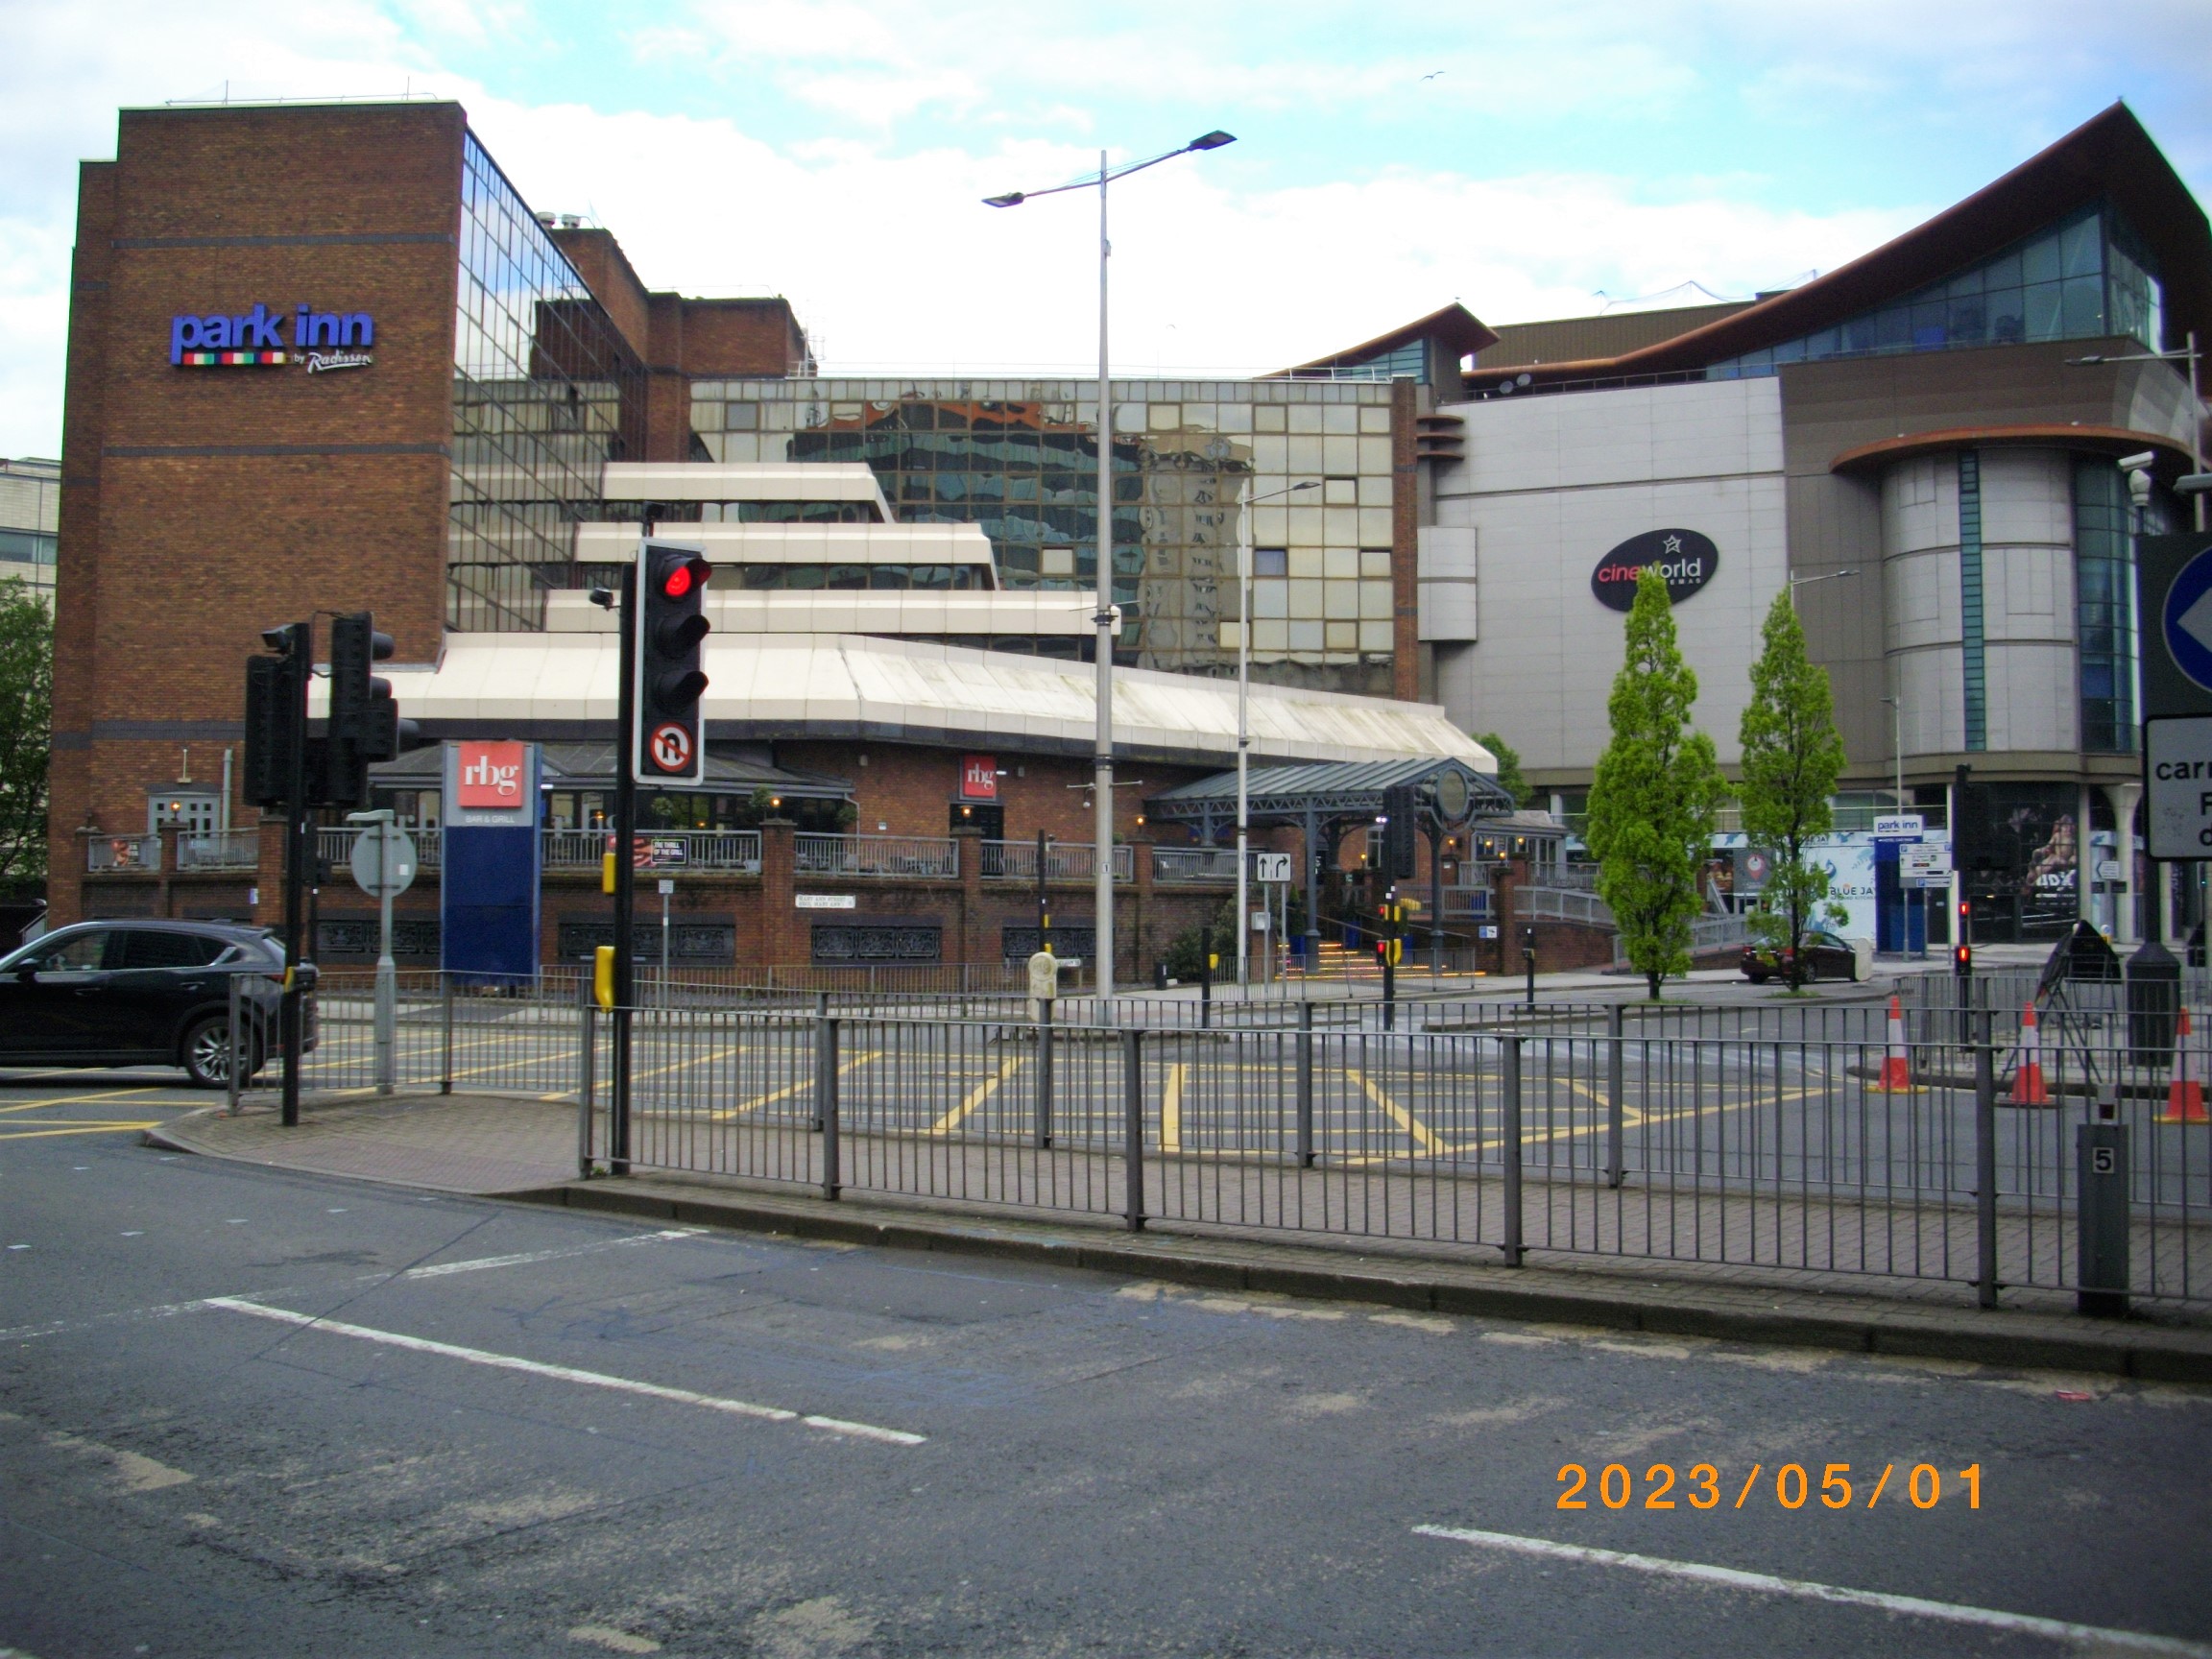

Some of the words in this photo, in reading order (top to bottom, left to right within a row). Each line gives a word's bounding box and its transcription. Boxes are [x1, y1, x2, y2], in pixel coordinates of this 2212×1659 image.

[170, 302, 284, 366] park
[296, 303, 373, 347] inn
[294, 353, 304, 364] by
[307, 349, 373, 374] Radisson
[464, 755, 519, 796] rbg
[967, 763, 995, 790] rbg
[1878, 820, 1900, 832] park
[1902, 820, 1918, 830] inn
[1830, 886, 1857, 896] BLUE
[1861, 886, 1876, 896] JA
[2096, 1148, 2112, 1171] 5
